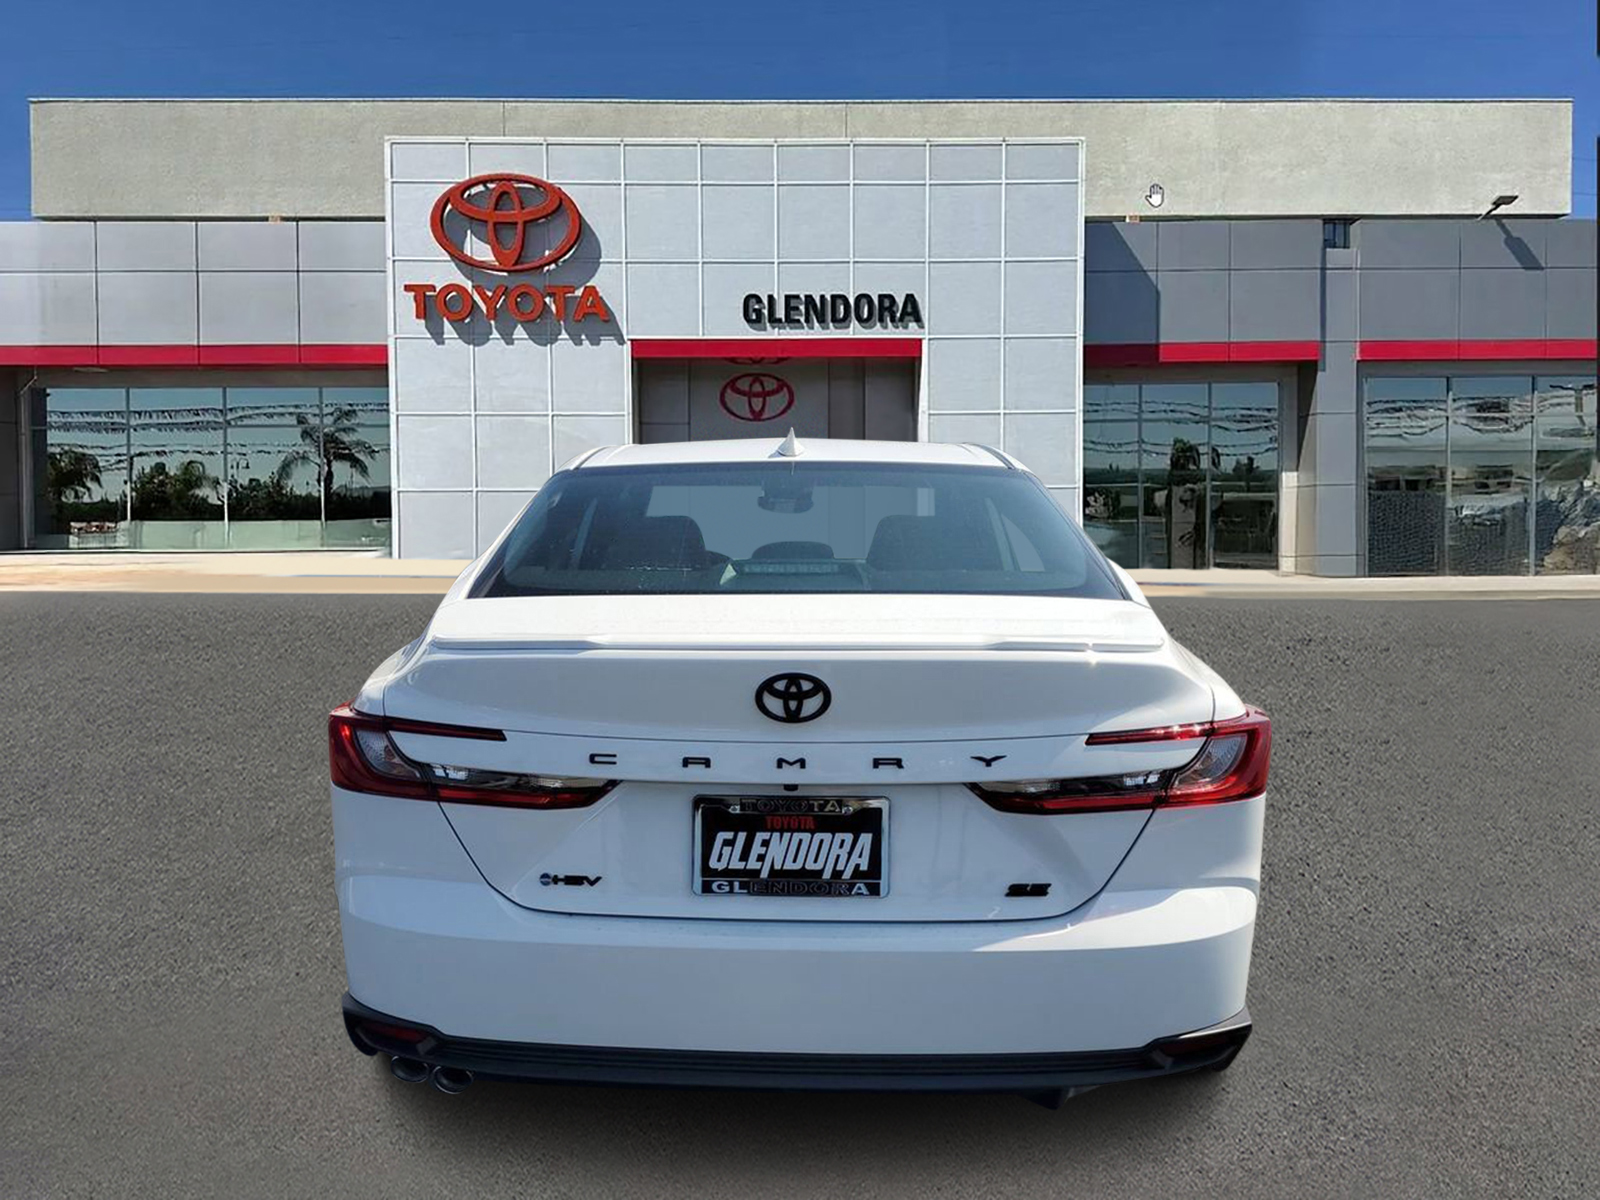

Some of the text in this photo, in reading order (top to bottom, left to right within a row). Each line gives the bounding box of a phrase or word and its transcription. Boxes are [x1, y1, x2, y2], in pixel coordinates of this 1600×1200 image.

[403, 283, 610, 324] TOYOTA
[742, 293, 923, 328] GLENDORA
[588, 753, 1007, 770] CAMRY
[741, 799, 842, 813] TOYOTA
[765, 815, 815, 830] TOYOTA
[708, 831, 873, 880] GLENDORA
[711, 880, 870, 895] GLENDORA
